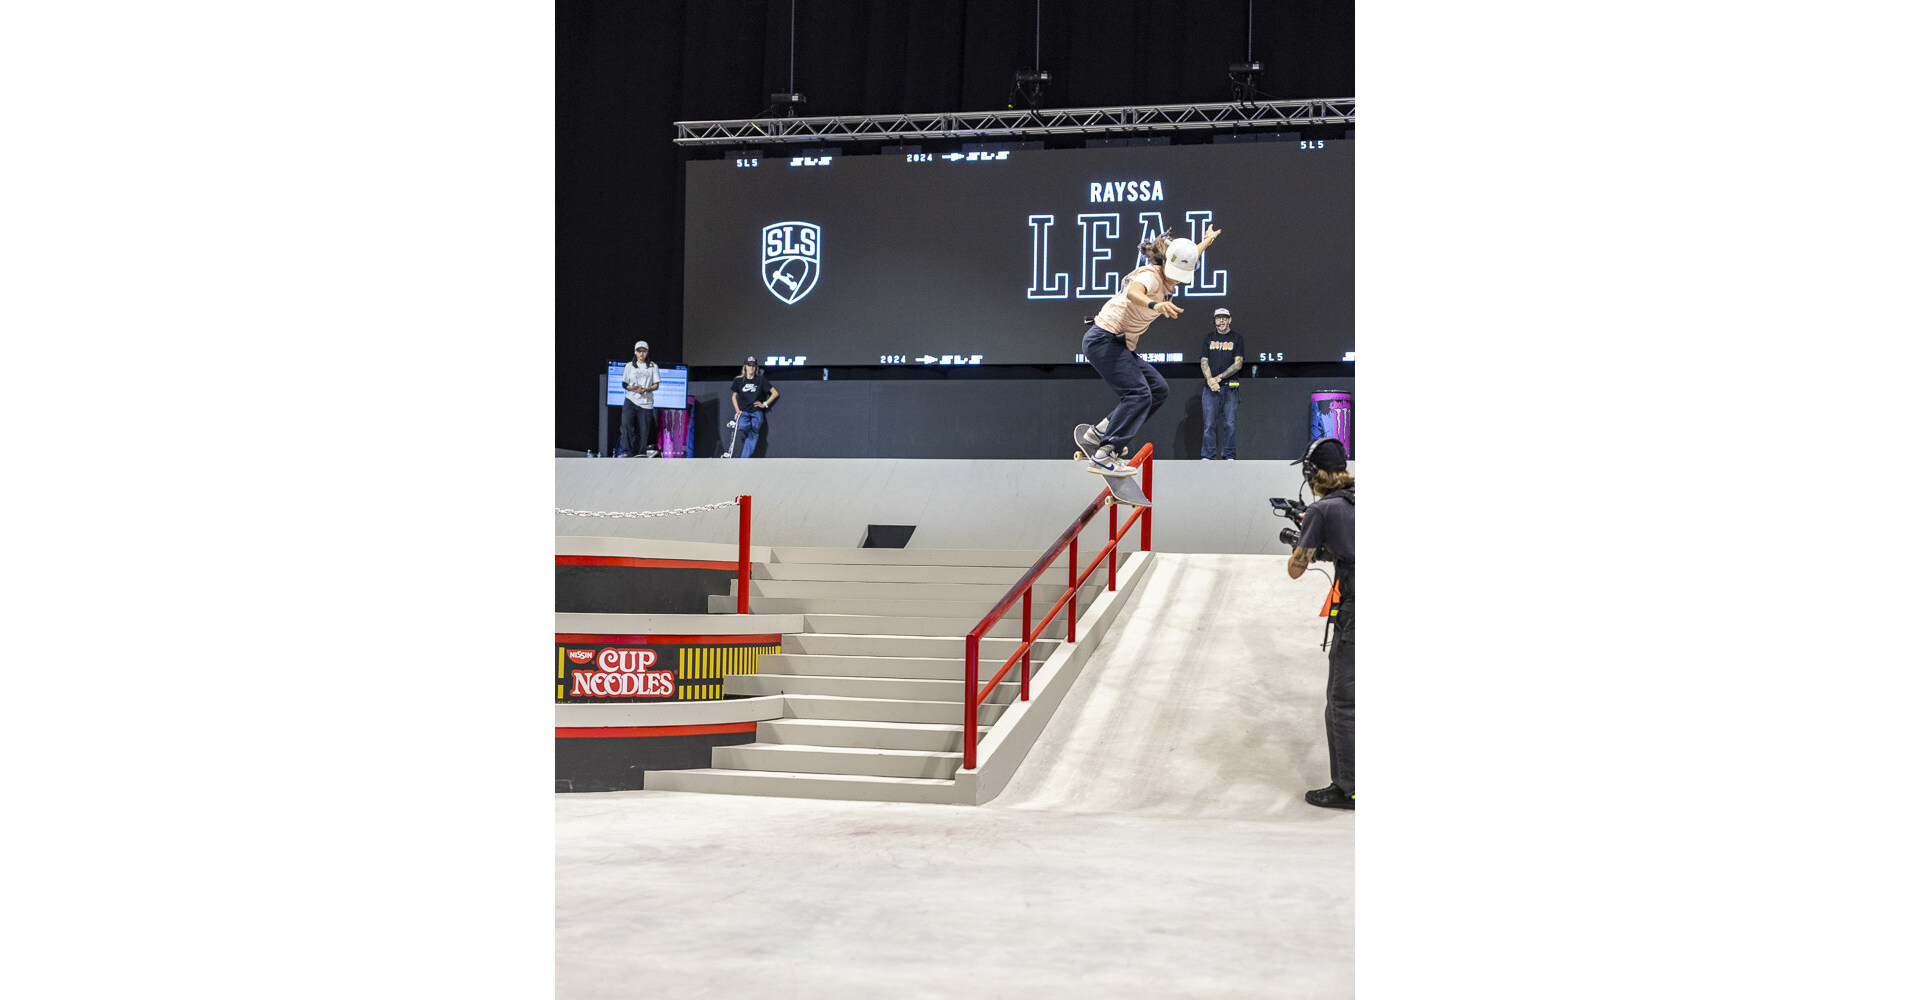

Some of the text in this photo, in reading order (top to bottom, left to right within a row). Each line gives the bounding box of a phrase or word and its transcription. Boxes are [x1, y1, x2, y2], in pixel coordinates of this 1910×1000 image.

[736, 158, 758, 167] SLS
[906, 153, 933, 162] 2024
[1090, 180, 1164, 202] RAYSSA
[767, 226, 816, 256] SLS
[880, 355, 907, 364] 2024
[569, 651, 593, 660] NISSIN
[600, 649, 656, 673] CUP
[571, 672, 674, 695] NOODLES
